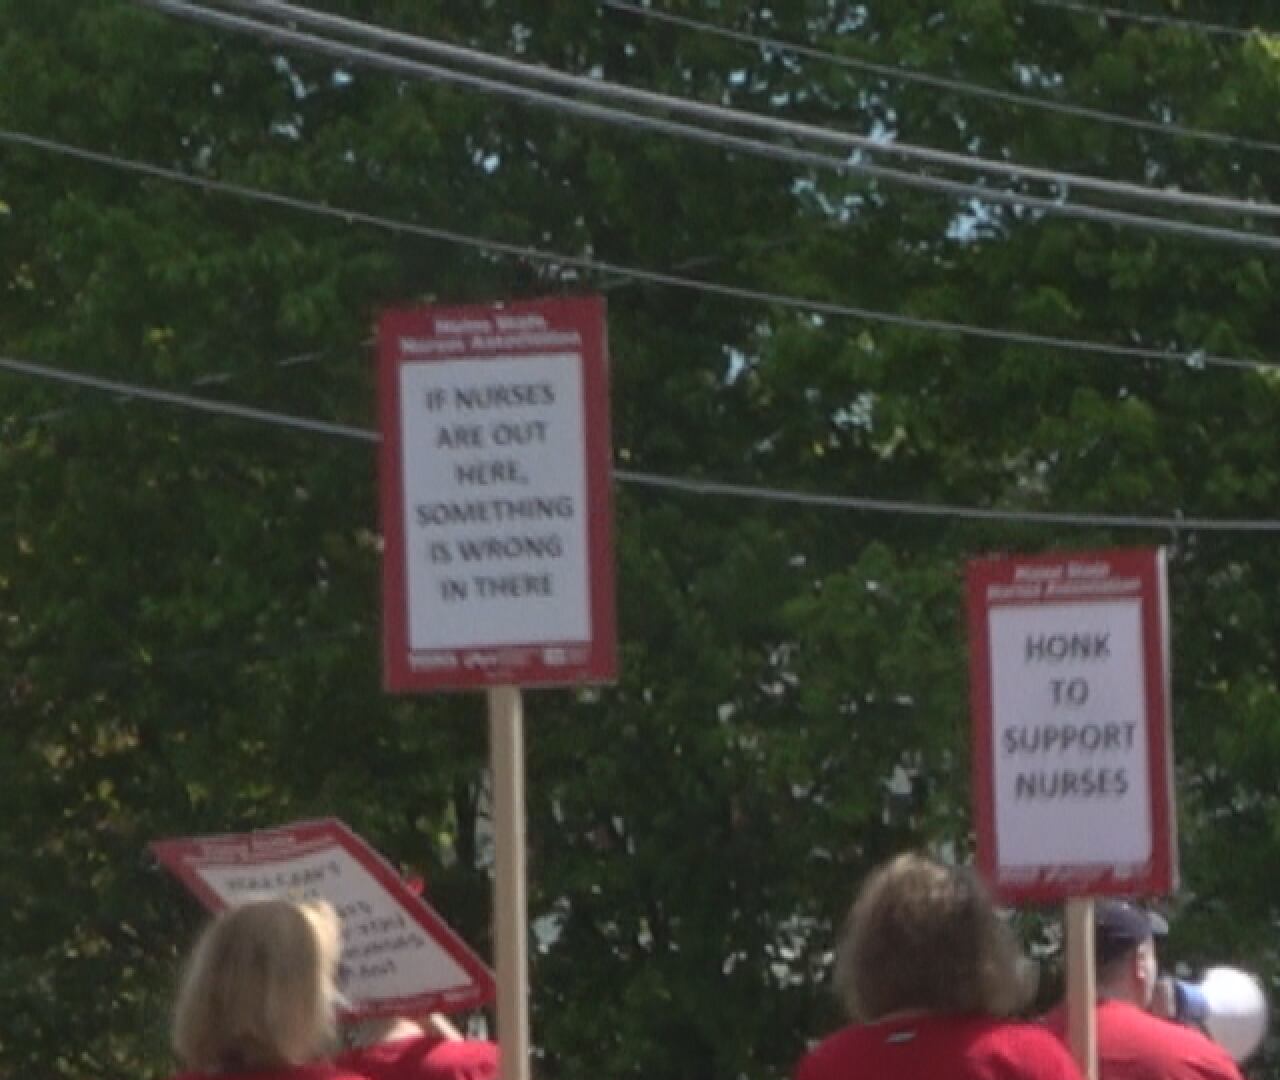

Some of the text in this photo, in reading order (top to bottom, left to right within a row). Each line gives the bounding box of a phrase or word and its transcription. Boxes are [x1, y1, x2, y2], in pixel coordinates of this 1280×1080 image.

[426, 383, 556, 413] IF NURSES
[436, 421, 548, 450] ARE OUT
[454, 461, 530, 487] HERE,
[416, 497, 575, 528] SOMETHING
[431, 534, 563, 565] IS WRONG
[440, 573, 553, 602] IN THERE
[1024, 632, 1111, 662] HONK
[1049, 677, 1089, 706] TO
[1002, 722, 1137, 754] SUPPORT
[1014, 769, 1129, 799] NURSES
